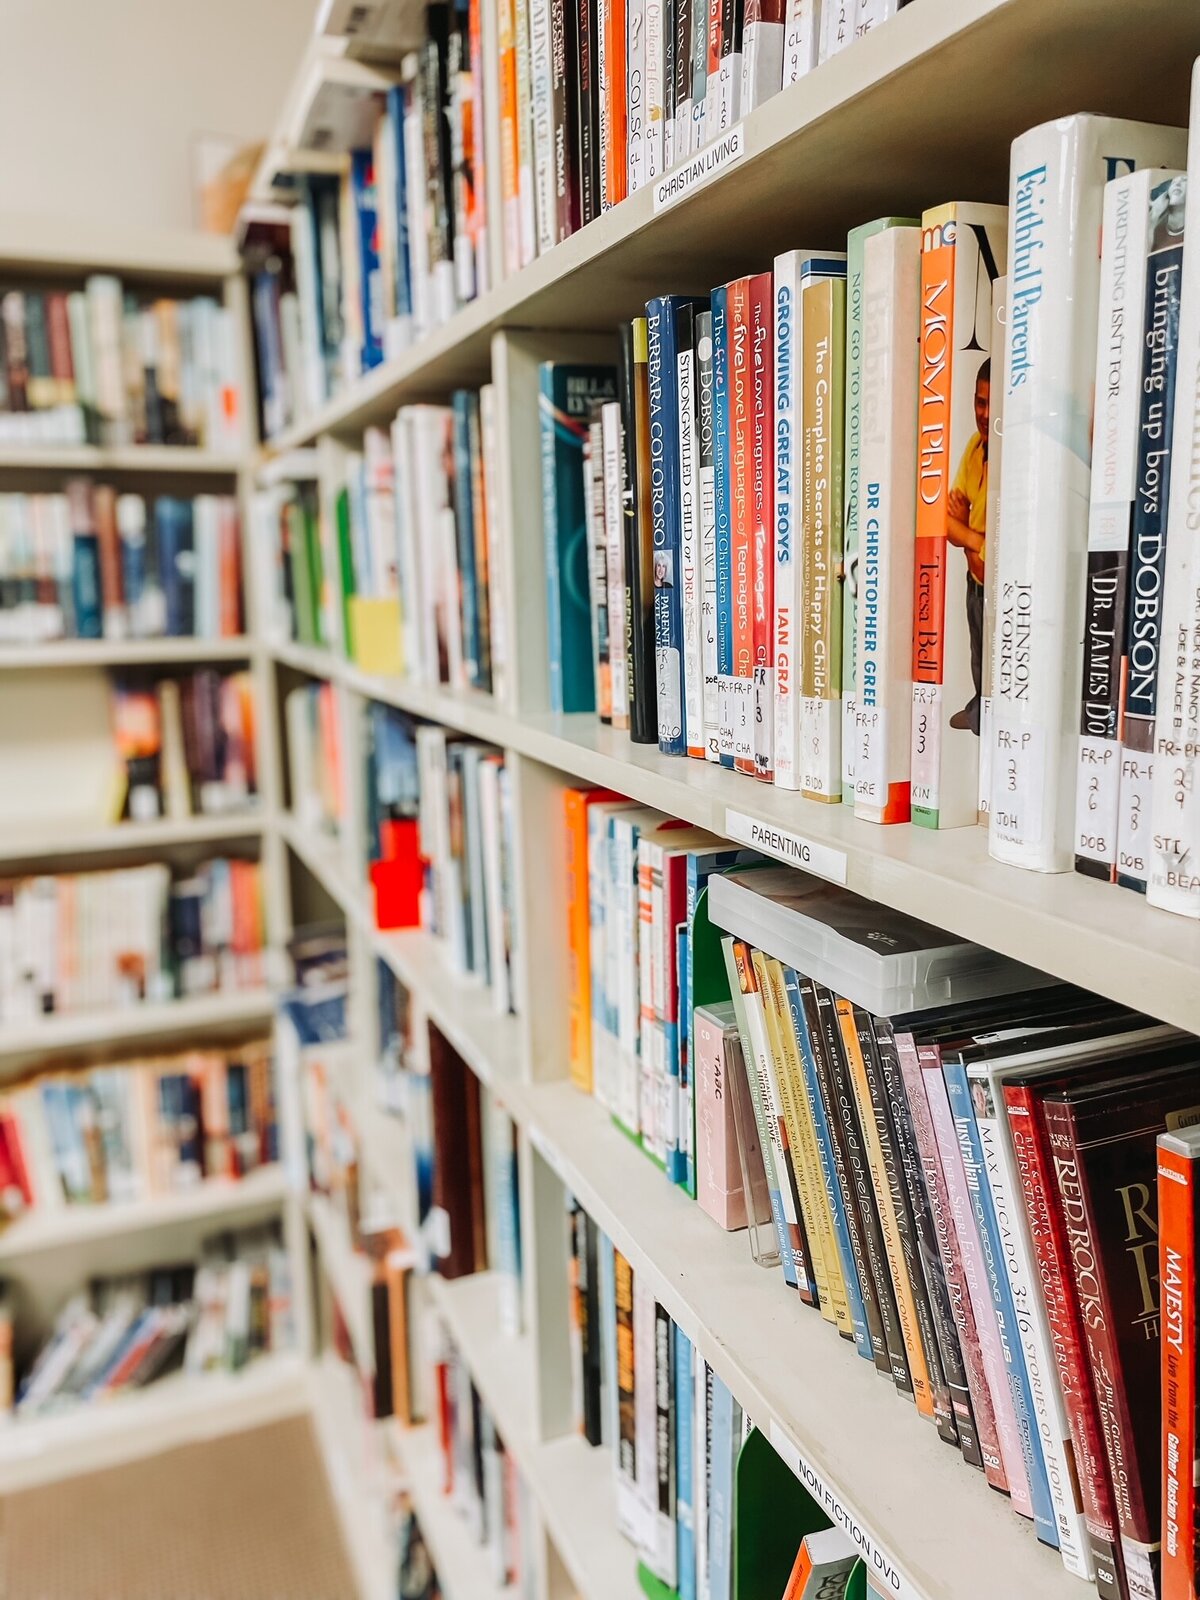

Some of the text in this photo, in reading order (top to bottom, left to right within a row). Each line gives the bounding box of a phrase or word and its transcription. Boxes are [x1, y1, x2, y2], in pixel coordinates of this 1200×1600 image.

[647, 4, 660, 57] Chicken
[720, 68, 730, 82] CL
[788, 32, 801, 47] CL
[647, 127, 658, 139] CL
[658, 134, 738, 203] CHRISTIAN LIVING
[693, 102, 706, 121] CL
[714, 309, 724, 344] The
[1008, 163, 1048, 396] Faithful Parents,
[920, 280, 948, 505] MOM PhD
[1103, 187, 1130, 497] PARENTING ISN'T FOR COWARDS
[1139, 263, 1180, 514] bringing up boys
[648, 313, 666, 546] BARBARA COLOROSO
[680, 354, 693, 541] STRONG-WILLED CHILD
[700, 369, 713, 457] DOBSON
[715, 392, 725, 430] Love
[734, 291, 749, 630] The five Love Languages Teenagers
[849, 272, 861, 532] NOW GO TO YOUR ROOM!
[716, 433, 727, 511] Languages
[753, 301, 767, 622] The five Love Languages Teenagers
[776, 286, 790, 645] GROWING GREAT BOYS IAN
[811, 336, 828, 635] The Complete Secrets of Happy
[703, 480, 716, 570] THE NEW
[718, 540, 728, 604] Children
[864, 482, 880, 652] DR CHRISTOPHER
[917, 555, 940, 672] Teresa Bell
[1000, 582, 1013, 701] & YORKEY
[1014, 580, 1032, 703] JOHNSON
[1088, 575, 1119, 695] DR. JAMES
[1130, 533, 1163, 703] DOBSON
[1173, 623, 1188, 713] JOE & ALICE
[754, 668, 766, 686] FR
[913, 688, 937, 704] FR-P
[735, 743, 751, 753] CHA
[856, 780, 876, 795] GRE
[912, 786, 930, 800] KIN
[998, 730, 1031, 750] FR-P
[1081, 747, 1112, 765] FR-P
[751, 824, 811, 862] PARENTING
[996, 812, 1018, 829] JOH
[1080, 834, 1107, 853] DOB
[1120, 852, 1144, 871] DOB
[741, 1034, 774, 1181] depression the path recovery
[757, 1070, 777, 1143] HIGHER LOVE
[760, 1054, 783, 1153] ESSENTIALS MARRIAGE
[800, 1055, 841, 1227] Vocal Band REUNION
[826, 1023, 873, 1224] THE BEST david phelps
[863, 1053, 908, 1234] SPECIAL HOMECOMING
[880, 1056, 924, 1238] How Great Thou Art
[776, 1223, 786, 1250] Mullen
[797, 1163, 806, 1188] TIME
[802, 1189, 816, 1236] FAVORITE
[816, 1054, 872, 1301] Gloria Gaither OLD RUGGED CROSS
[818, 1190, 831, 1236] FAVORITE
[871, 1163, 915, 1352] TENT REVIVAL HOMECOMING
[922, 1156, 956, 1277] Homecoming
[949, 1282, 968, 1334] Picnic
[954, 1114, 1013, 1364] Australian HOMECOMING PLUS
[960, 1239, 978, 1291] EASTER
[1013, 1131, 1073, 1395] CHRISTMAS IN SOUTH AFRICA
[1034, 1184, 1064, 1302] GLORIA GAITHER
[1057, 1158, 1106, 1332] RED ROCKS
[981, 1126, 1065, 1508] MAX LUCADO 3:16 STORIES OF HOPE
[1105, 1385, 1132, 1520] BILL GLORIA GAITHER
[1166, 1245, 1184, 1558] MAJESTY Live from the Gaither Alaskan Cruise
[1100, 1400, 1125, 1528] HOMECOMING FRIENDS
[799, 1458, 822, 1498] NON
[825, 1491, 870, 1552] FICTION
[874, 1550, 900, 1590] DVD
[1098, 1568, 1114, 1582] DVD
